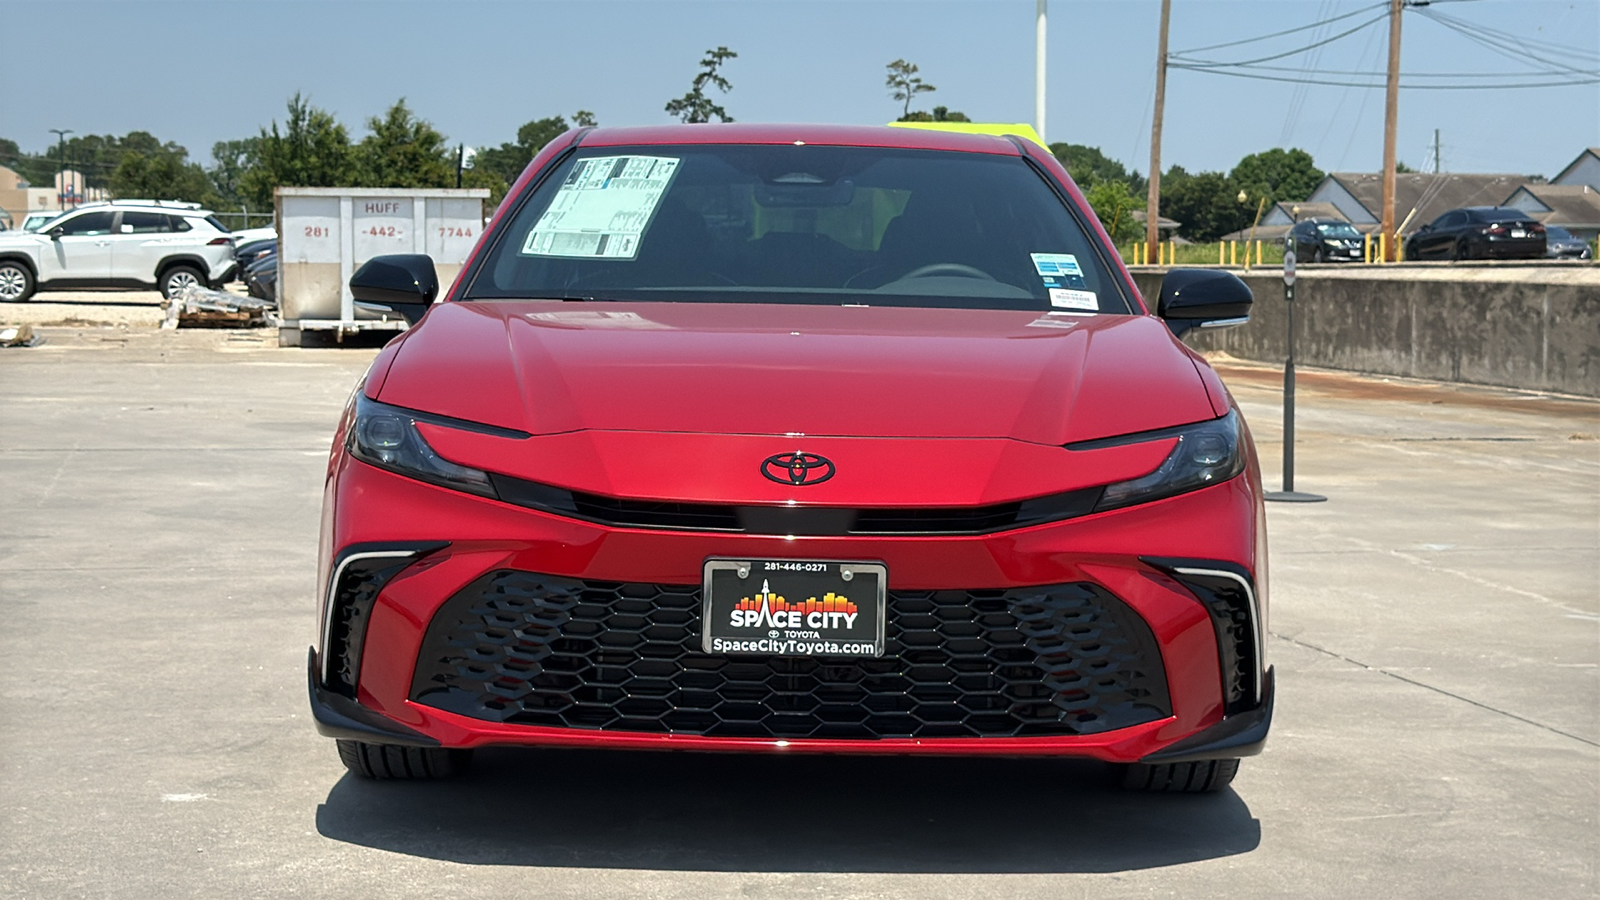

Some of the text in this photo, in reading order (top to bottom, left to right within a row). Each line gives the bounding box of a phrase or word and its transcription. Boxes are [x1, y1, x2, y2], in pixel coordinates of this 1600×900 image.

[365, 202, 400, 214] HUFF
[305, 226, 330, 238] 281
[439, 227, 473, 238] 7744
[764, 562, 828, 572] 281-446-0271
[730, 609, 858, 630] SPACE CITY
[784, 630, 820, 639] TOYOTA
[713, 638, 875, 656] SpaceCityToyota.com
